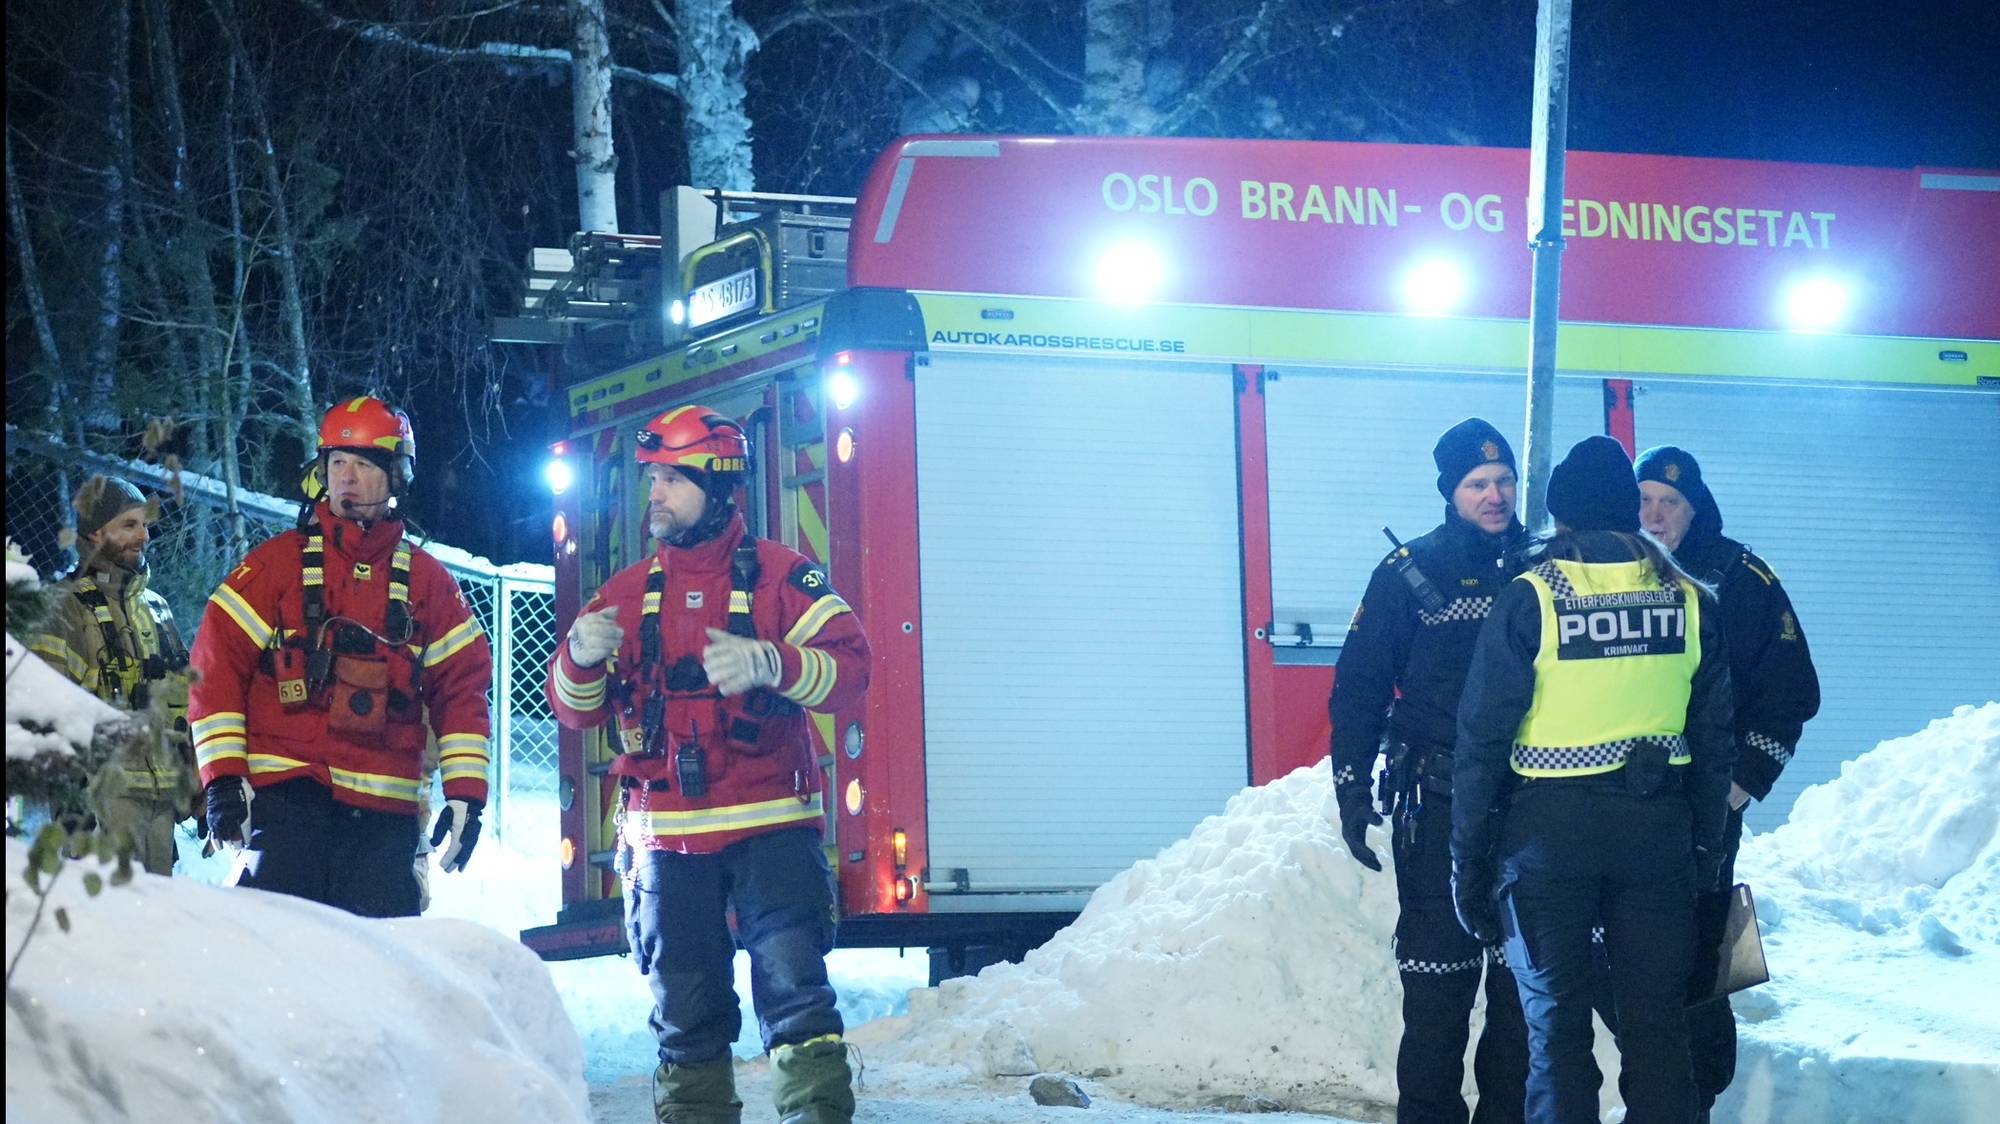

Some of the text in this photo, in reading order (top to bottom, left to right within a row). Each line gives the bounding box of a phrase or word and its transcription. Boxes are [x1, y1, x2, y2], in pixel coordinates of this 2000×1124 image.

[1102, 172, 1836, 249] OSLO BRANN- OG EDNINGSETAT
[932, 330, 1185, 353] AUTOKAROSSRESCUE.SE
[1565, 591, 1676, 611] ETTERFORSKNINGSLEDER
[1558, 607, 1686, 645] POLITI
[1603, 643, 1649, 657] KRIMVAKT
